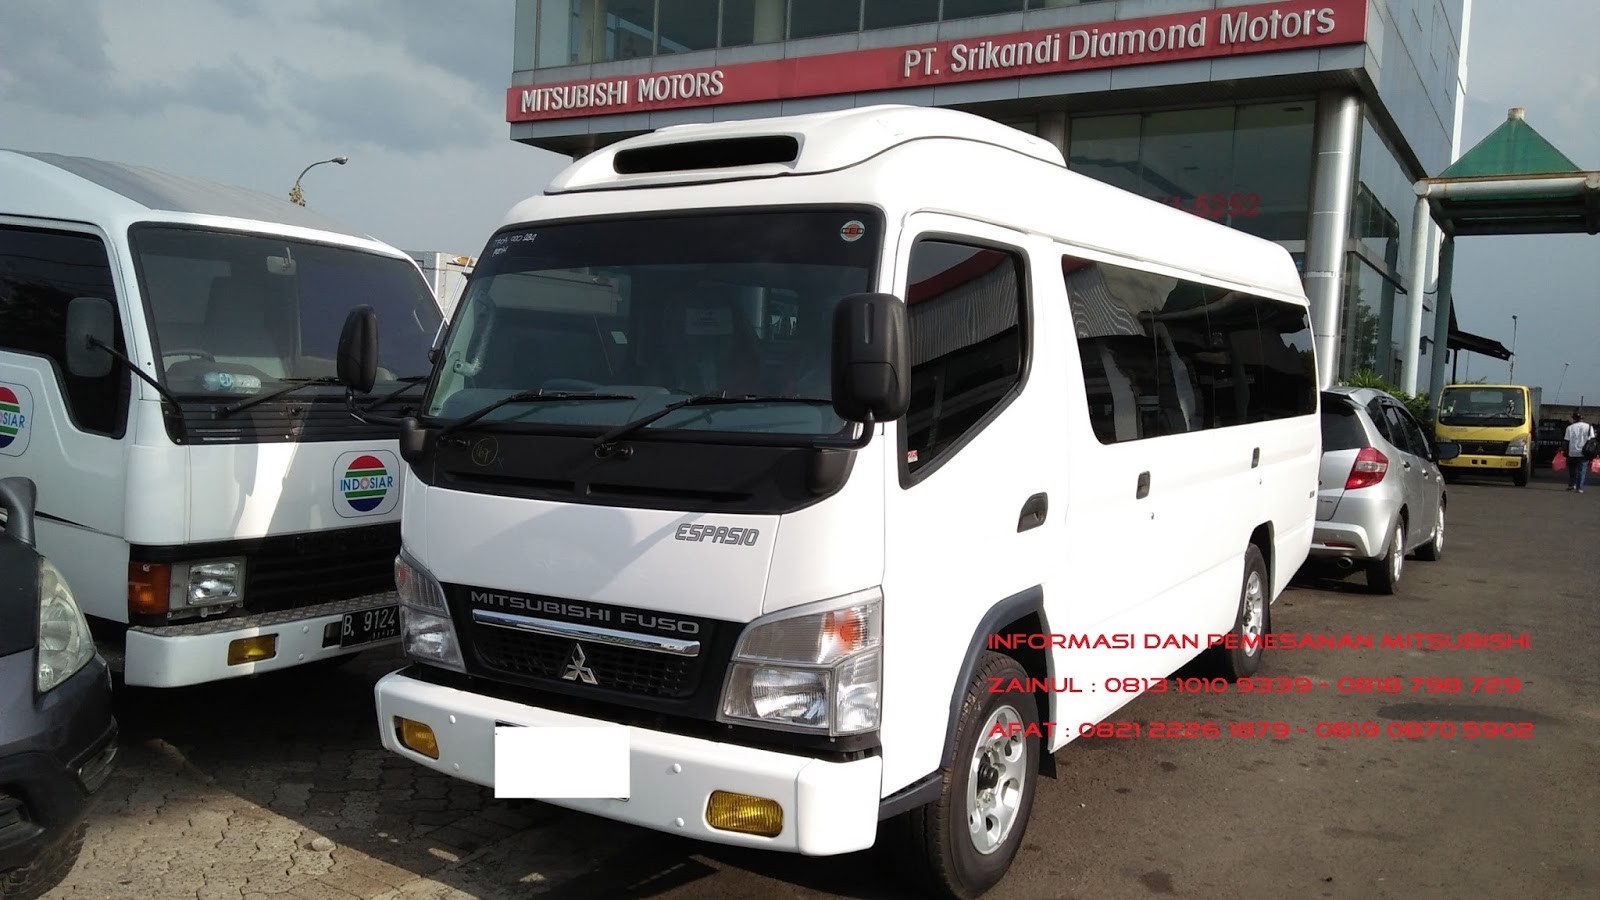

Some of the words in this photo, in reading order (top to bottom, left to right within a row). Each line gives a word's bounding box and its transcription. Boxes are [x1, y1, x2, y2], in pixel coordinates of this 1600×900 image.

[904, 47, 940, 77] PT.
[950, 33, 1060, 73] Srikandi
[1068, 17, 1207, 61] Diamond
[1219, 7, 1335, 44] Motors
[521, 80, 628, 113] MITSUBISHI
[637, 70, 724, 103] MOTORS
[340, 475, 394, 492] INDOSIAR
[675, 523, 760, 547] ESPASIO
[363, 606, 396, 632] 9124
[470, 590, 611, 622] MITSUBISHI
[620, 611, 700, 635] FUSO
